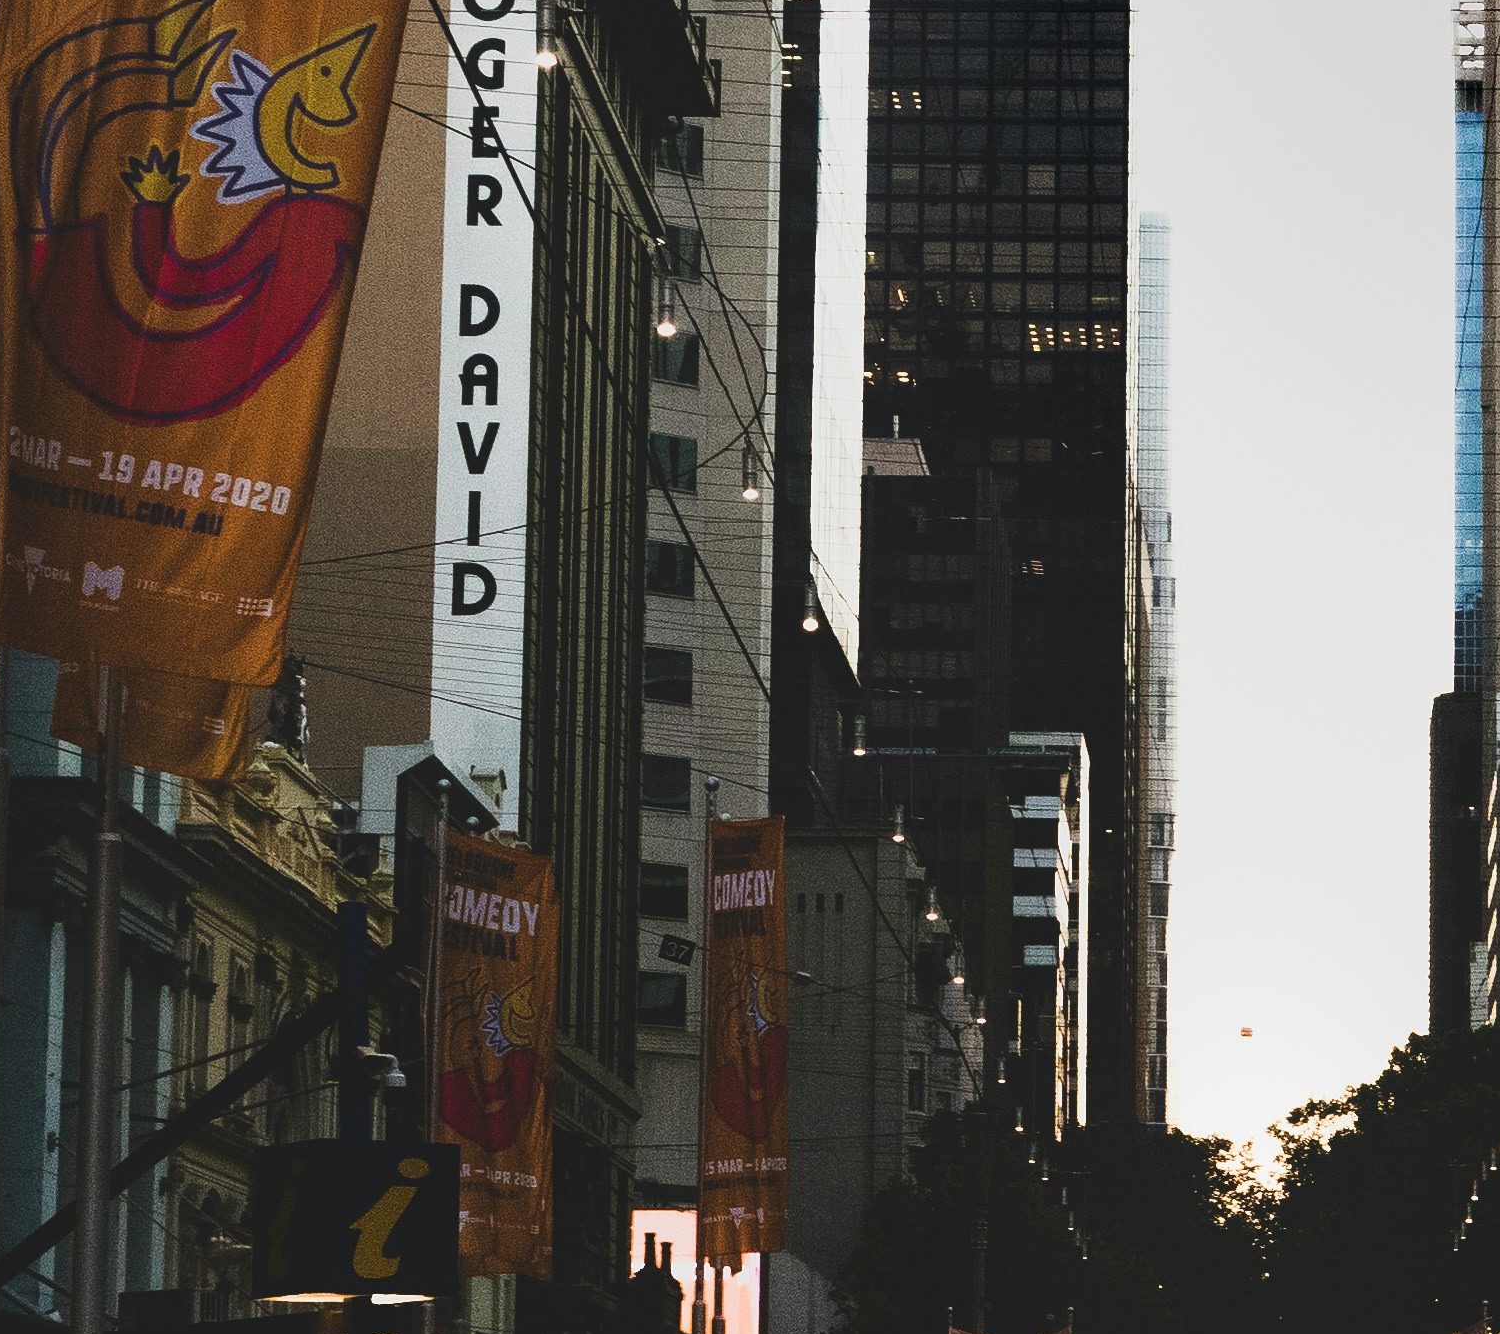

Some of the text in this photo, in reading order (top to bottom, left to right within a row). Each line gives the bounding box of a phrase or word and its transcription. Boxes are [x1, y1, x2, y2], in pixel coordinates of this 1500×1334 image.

[452, 284, 499, 615] DAVID
[98, 450, 135, 484] 19
[141, 459, 204, 499] APR
[211, 471, 292, 516] 2020
[714, 870, 776, 911] COMEDY
[665, 941, 689, 959] 37
